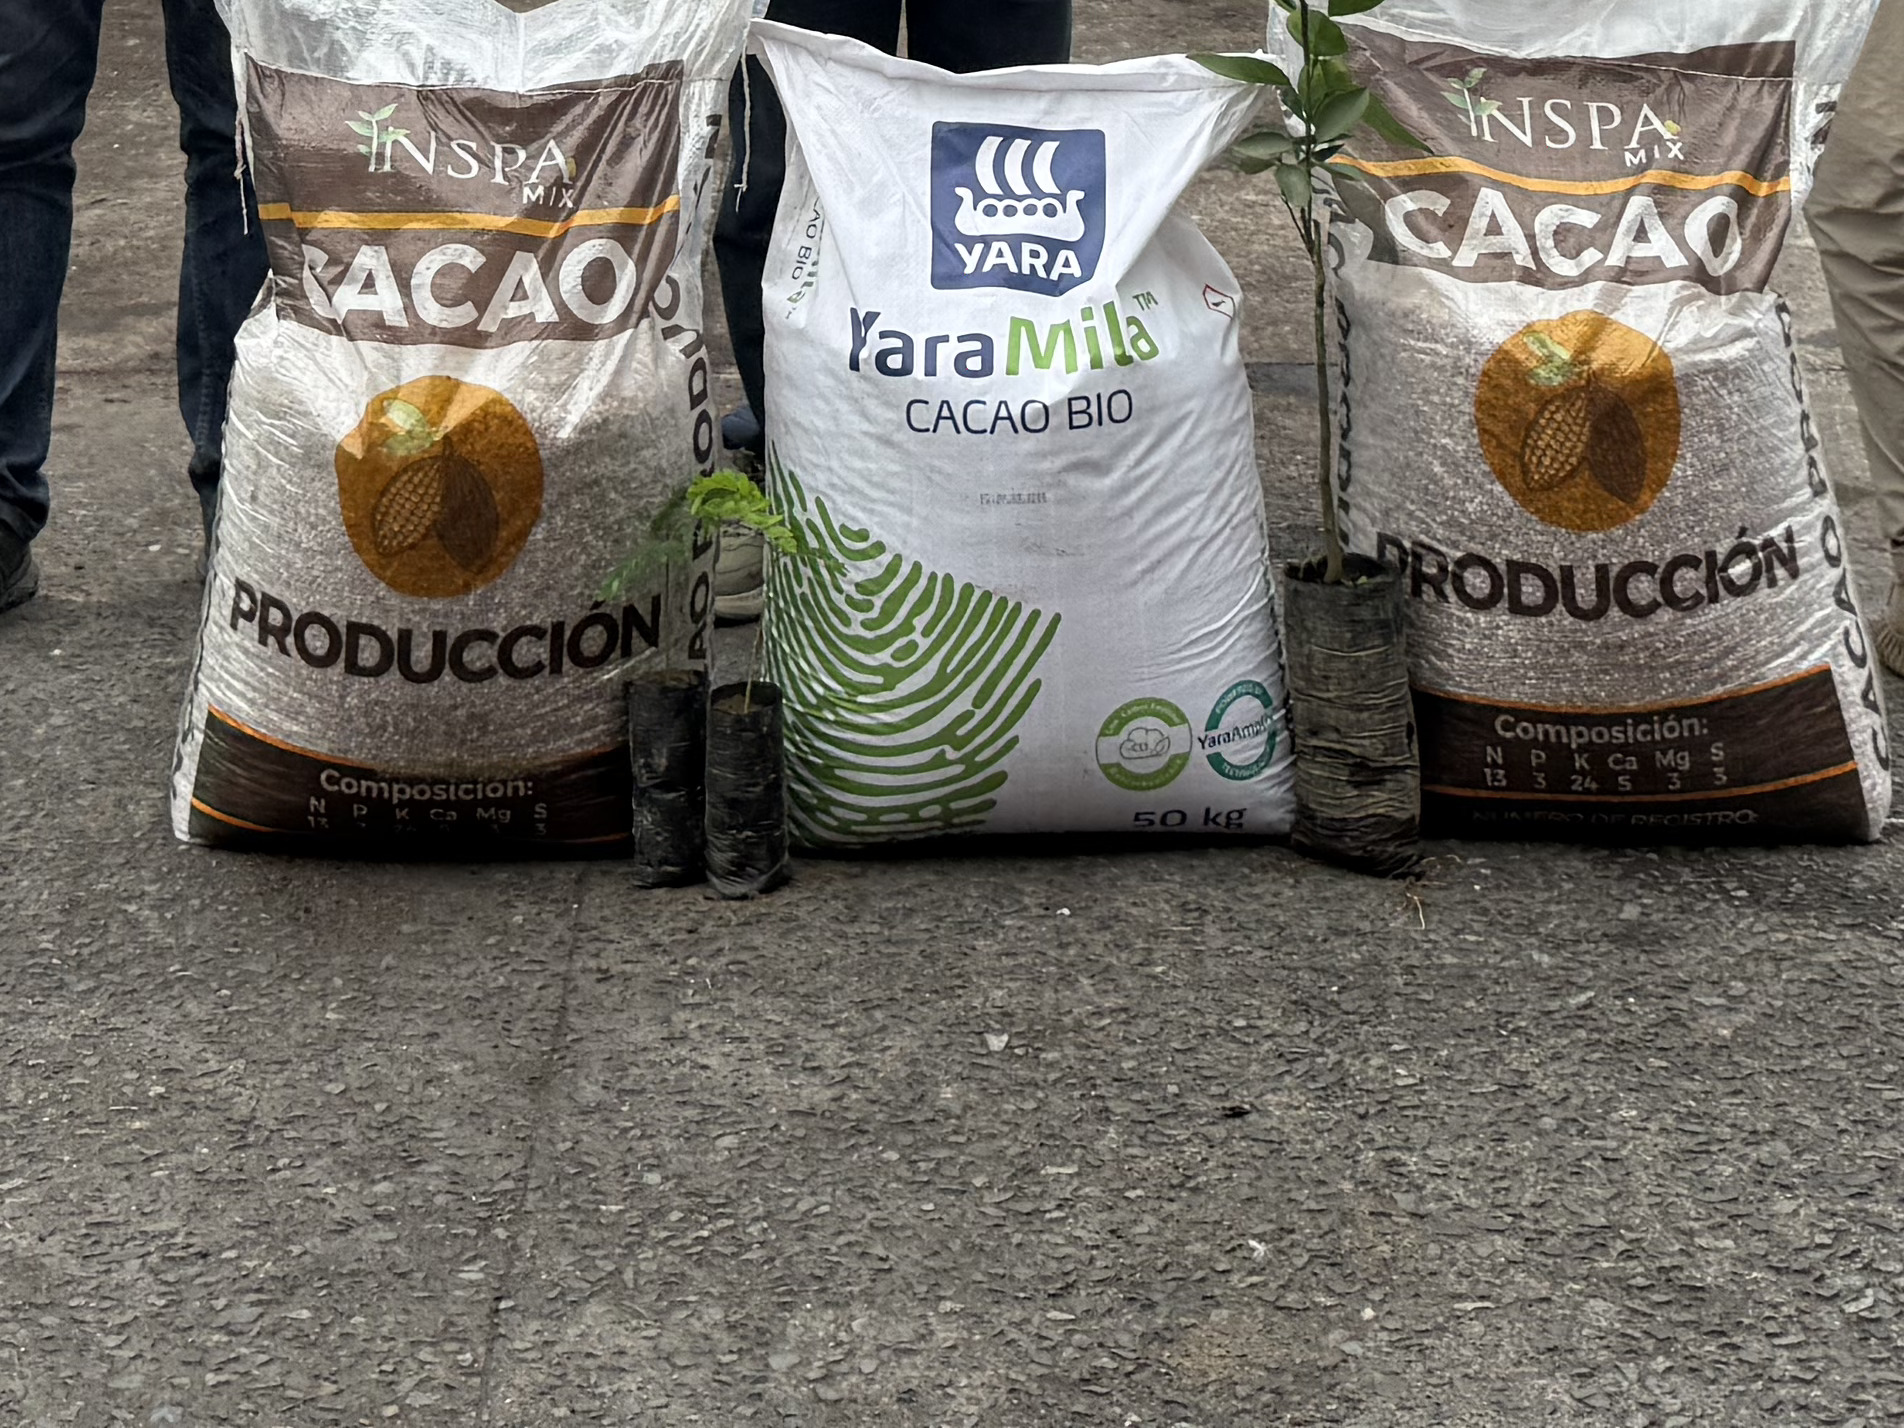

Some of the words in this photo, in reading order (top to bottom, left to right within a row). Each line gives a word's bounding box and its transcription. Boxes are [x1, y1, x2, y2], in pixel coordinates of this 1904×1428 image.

[1466, 88, 1675, 152] INSPA
[368, 116, 575, 185] INSPA
[1623, 139, 1686, 168] MIX
[521, 183, 575, 209] MIX
[1384, 186, 1742, 277] CACAO
[953, 241, 1083, 281] YARA
[302, 237, 637, 334] CACAO
[904, 397, 1051, 436] CACAO
[1066, 389, 1134, 431] BIO
[1376, 524, 1800, 622] PRODUCCIÓN
[228, 575, 662, 685] PRODUCCIÓN
[1494, 713, 1709, 750] Composición:
[1485, 745, 1503, 765] N
[1530, 749, 1546, 767] P
[1573, 752, 1590, 771] K
[1607, 752, 1638, 771] Ca
[1655, 749, 1691, 771] Mg
[1709, 742, 1726, 762] S
[1483, 767, 1508, 787] 13
[309, 795, 326, 815] N
[352, 803, 368, 820] P
[475, 806, 512, 825] Mg
[533, 802, 548, 820] S
[1132, 809, 1188, 828] 50
[1202, 806, 1248, 831] kg
